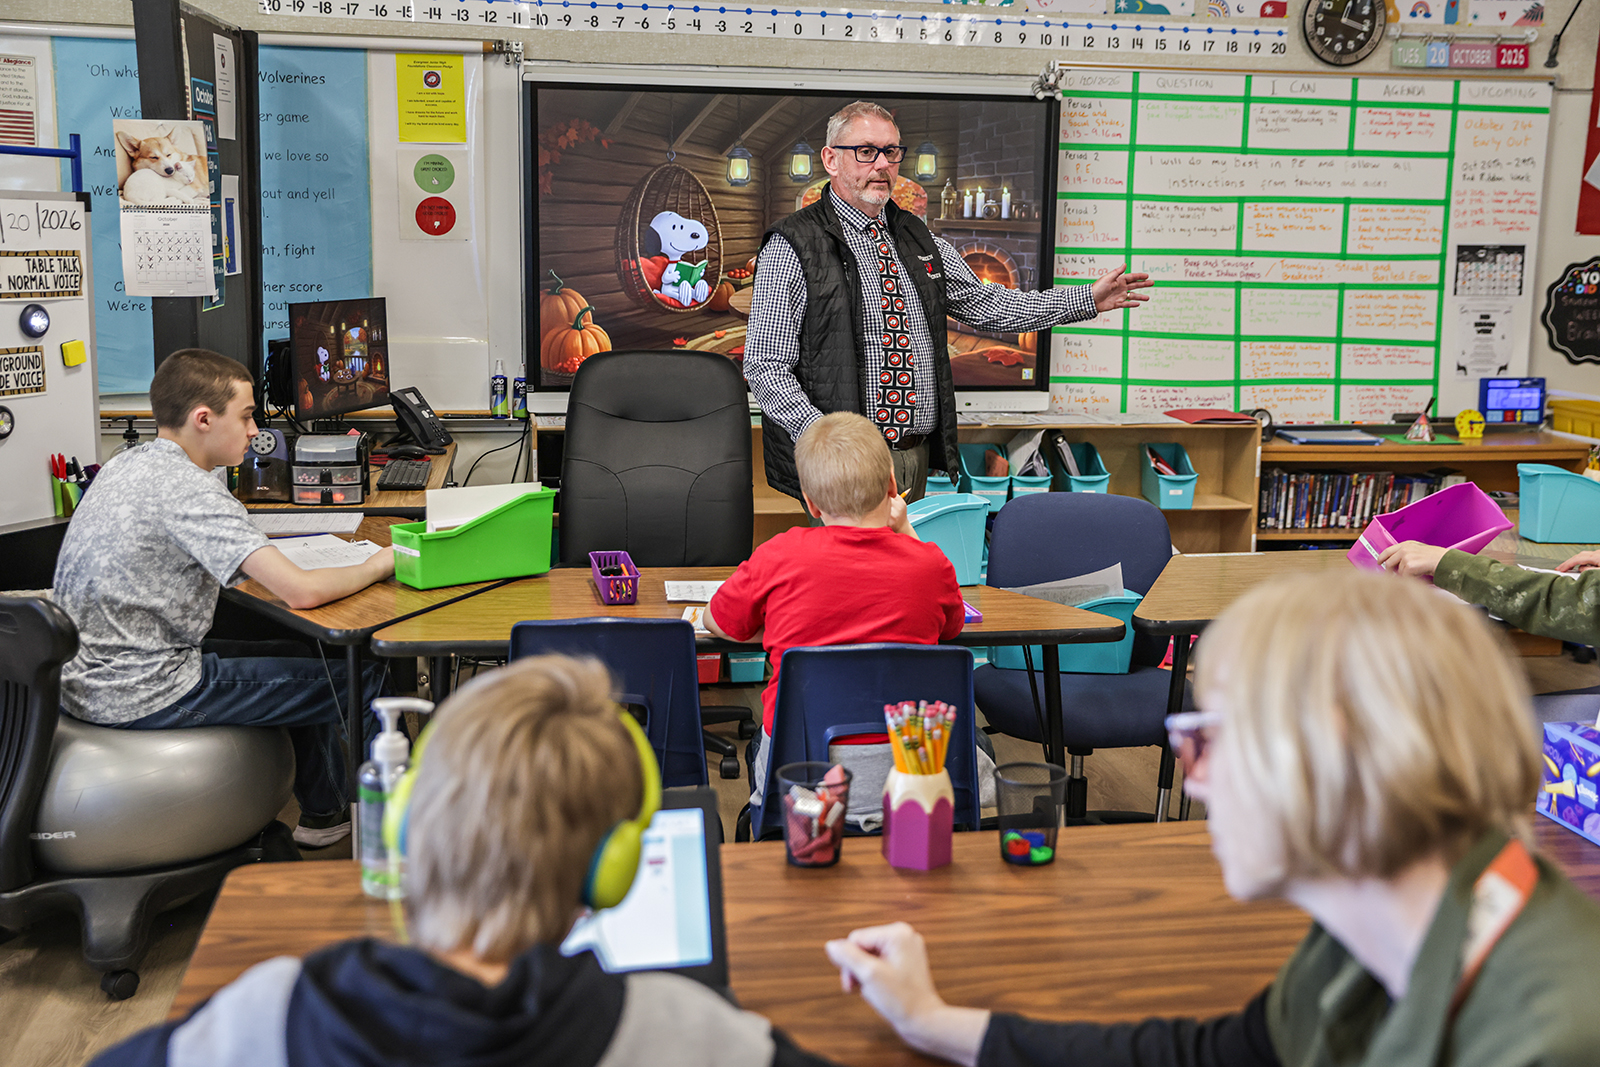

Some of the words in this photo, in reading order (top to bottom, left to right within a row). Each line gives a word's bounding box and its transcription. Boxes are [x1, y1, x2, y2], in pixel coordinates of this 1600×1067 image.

[286, 0, 305, 12] -19
[312, 1, 332, 14] -18
[340, 3, 359, 15] -17
[369, 5, 388, 17] -16
[396, 6, 413, 18] -15
[423, 7, 442, 19] -14
[450, 9, 469, 21] -13
[478, 11, 497, 23] -12
[506, 12, 521, 24] -11
[530, 13, 549, 26] -10
[556, 14, 572, 26] -9
[583, 15, 599, 27] -8
[612, 16, 625, 28] -7
[634, 17, 650, 29] -6
[660, 18, 676, 30] -5
[686, 19, 701, 31] -4
[714, 20, 726, 32] -3
[739, 21, 753, 33] -2
[766, 22, 776, 34] -1
[794, 23, 802, 35] 0
[821, 24, 825, 35] 1
[844, 25, 853, 37] 2
[870, 26, 878, 38] 3
[896, 27, 903, 39] 4
[919, 28, 927, 40] 5
[944, 29, 952, 41] 6
[969, 31, 977, 42] 7
[994, 31, 1002, 43] 8
[1018, 32, 1026, 44] 9
[1040, 33, 1052, 45] 10
[1061, 36, 1069, 47] 11
[1083, 36, 1095, 48] 12
[1107, 37, 1120, 48] 13
[1131, 37, 1143, 49] 14
[1155, 38, 1167, 50] 15
[1179, 39, 1191, 51] 16
[1203, 40, 1215, 52] 17
[1226, 41, 1238, 53] 18
[1248, 41, 1261, 53] 19
[1271, 42, 1286, 54] 20
[1430, 47, 1446, 64] 20
[1452, 48, 1492, 64] OCTOBER
[1500, 48, 1526, 65] 2026
[258, 70, 326, 85] Wolverines
[1156, 77, 1214, 89] QUESTION
[1270, 80, 1278, 95] I
[1290, 80, 1316, 93] CAN
[1383, 84, 1426, 97] AGENDA
[1468, 87, 1537, 98] UPCOMING
[1067, 99, 1092, 109] Period
[277, 113, 309, 125] game
[1068, 119, 1089, 127] Social
[1464, 118, 1504, 131] October
[1473, 135, 1501, 151] Early
[1507, 135, 1532, 147] Out
[265, 152, 281, 160] we
[286, 149, 311, 161] love
[315, 152, 329, 161] so
[1065, 151, 1088, 160] Period
[1094, 152, 1100, 161] 2
[1160, 156, 1181, 165] will
[1189, 155, 1202, 165] do
[1211, 160, 1227, 173] my
[1234, 156, 1258, 169] best
[1270, 159, 1281, 169] in
[1291, 158, 1306, 169] PE
[1318, 160, 1334, 168] and
[1393, 162, 1411, 171] all
[1260, 180, 1287, 190] from
[1294, 175, 1331, 188] teachers
[1341, 179, 1356, 187] and
[262, 189, 282, 199] out
[287, 188, 309, 199] and
[313, 188, 335, 202] yell
[1063, 202, 1089, 215] Period
[1093, 204, 1098, 214] 3
[41, 209, 82, 230] 2026
[1063, 217, 1095, 233] Reading
[1180, 227, 1191, 237] my
[284, 244, 316, 259] fight
[25, 258, 54, 273] TABLE
[57, 258, 79, 273] TALK
[1057, 255, 1096, 265] LUNCH
[1203, 258, 1218, 268] and
[1372, 262, 1391, 272] and
[7, 275, 50, 290] NORMAL
[53, 275, 79, 289] VOICE
[1581, 272, 1600, 284] YO
[289, 283, 323, 292] score
[1575, 284, 1597, 294] DID
[107, 300, 147, 311] We're
[1063, 337, 1082, 347] Period
[1087, 337, 1093, 347] 5
[1065, 350, 1089, 361] Math
[14, 371, 42, 387] VOICE
[1065, 384, 1084, 394] Period
